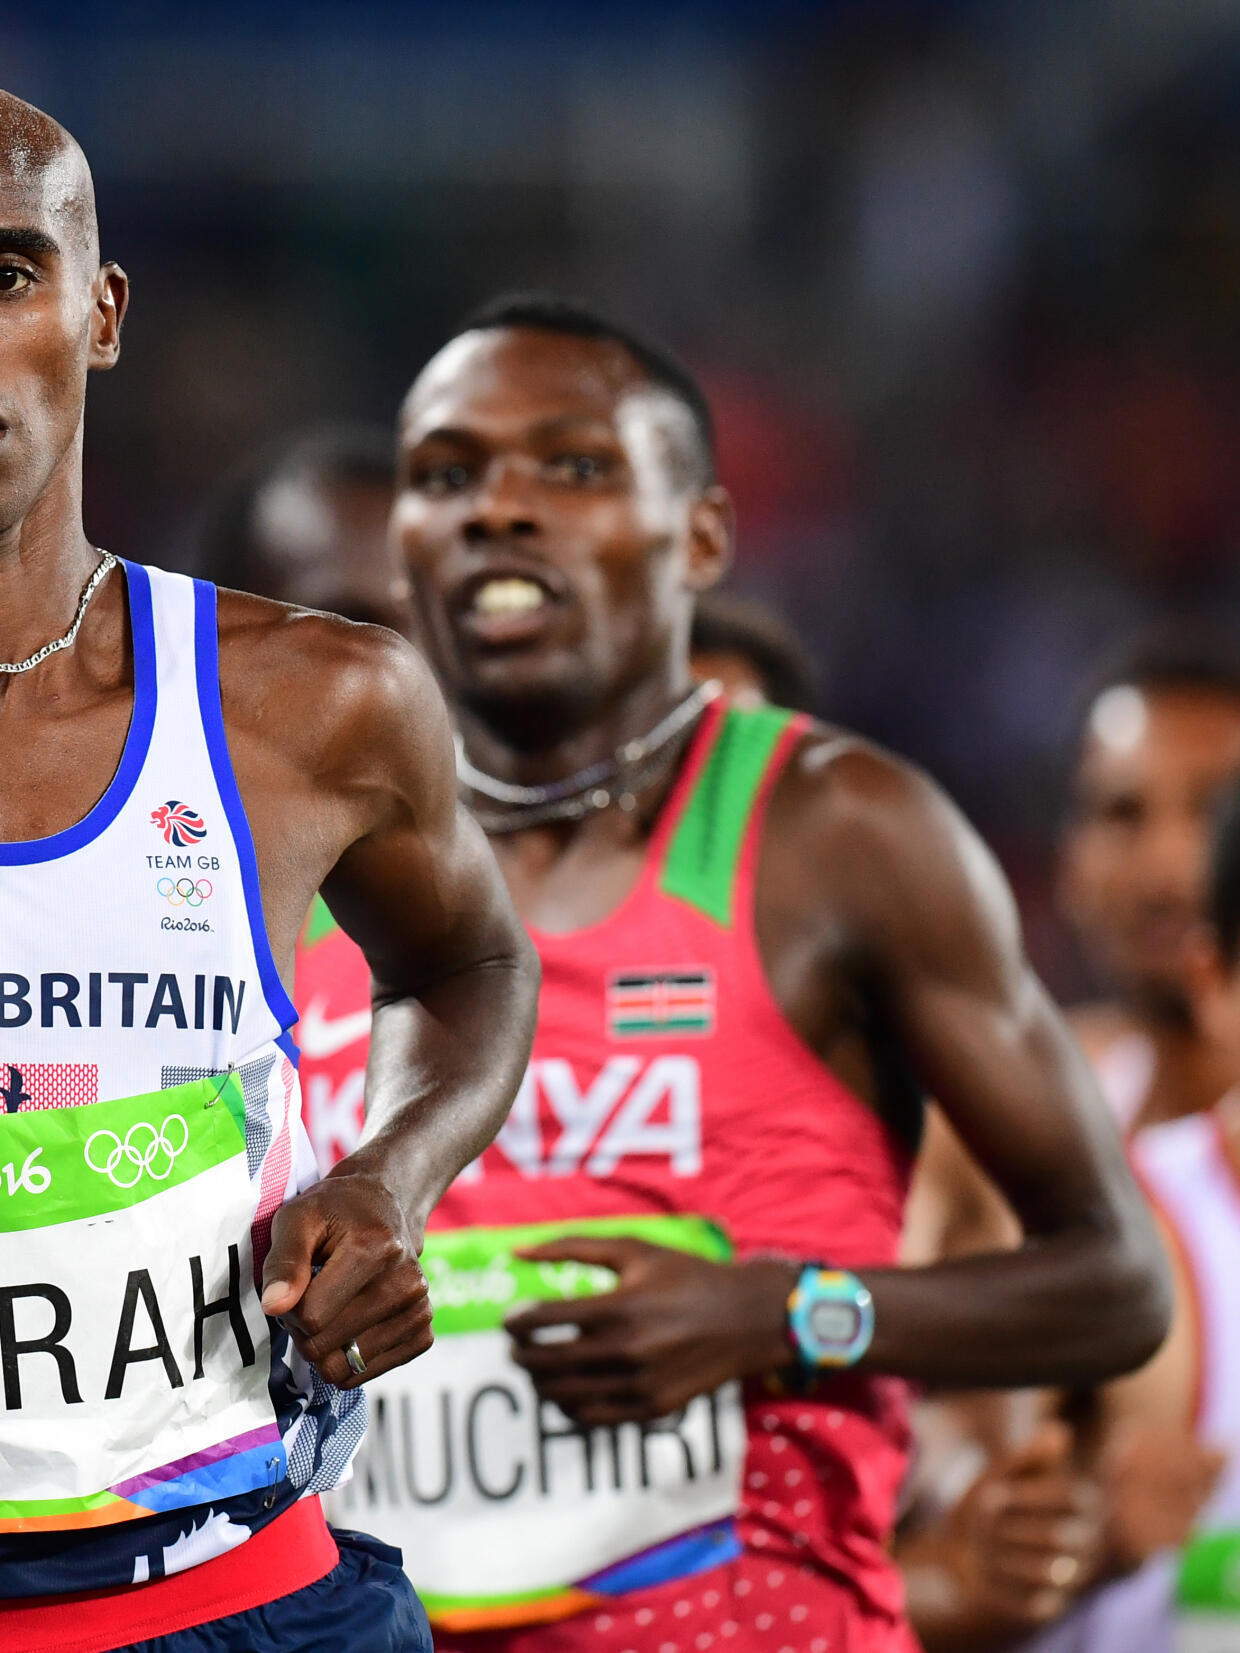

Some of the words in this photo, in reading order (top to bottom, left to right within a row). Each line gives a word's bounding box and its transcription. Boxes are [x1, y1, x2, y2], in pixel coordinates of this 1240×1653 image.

[146, 855, 192, 869] TEAM
[197, 855, 220, 871] GB
[306, 1055, 702, 1185] KNYA
